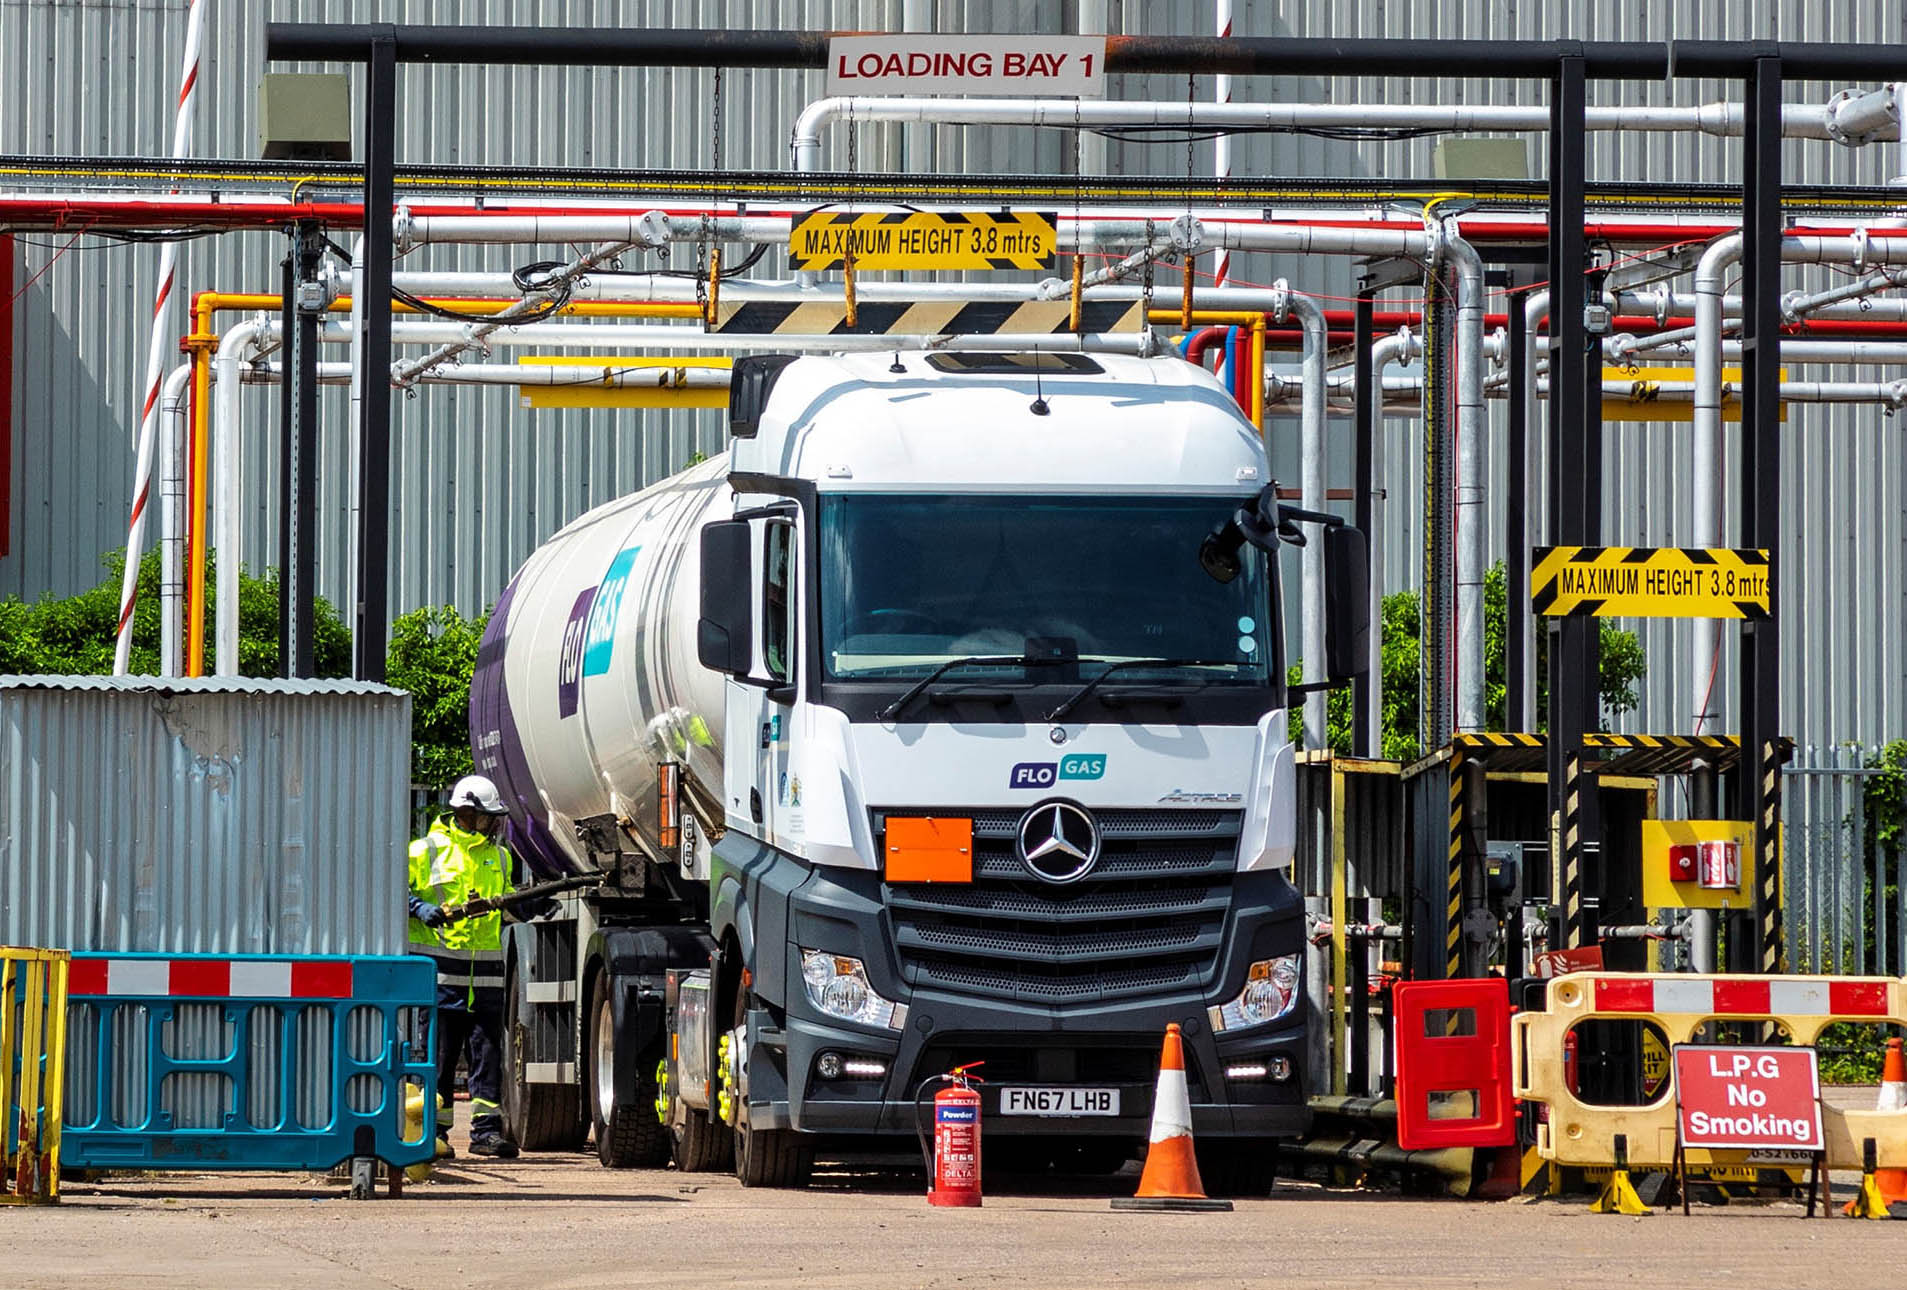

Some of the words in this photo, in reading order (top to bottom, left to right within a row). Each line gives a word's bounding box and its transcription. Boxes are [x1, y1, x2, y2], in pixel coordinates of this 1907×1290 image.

[838, 53, 992, 78] LOADING
[1003, 53, 1067, 77] BAY
[1079, 54, 1093, 77] 1
[804, 228, 890, 254] MAXIMUM
[899, 229, 964, 254] HEIGHT
[971, 226, 997, 254] 3.8
[1002, 231, 1041, 254] mtrs
[1562, 568, 1639, 595] MAXIMUM
[1646, 569, 1703, 596] HEIGHT
[1711, 569, 1735, 597] 3.8
[1017, 768, 1052, 783] FLO
[1065, 760, 1101, 774] GAS
[1709, 1055, 1780, 1078] L.P.G
[1010, 1092, 1064, 1110] FN67
[1071, 1093, 1111, 1111] LHB
[1727, 1084, 1767, 1108] No
[943, 1111, 973, 1119] Powder
[1690, 1112, 1810, 1141] Smoking
[945, 1170, 972, 1178] DELTA
